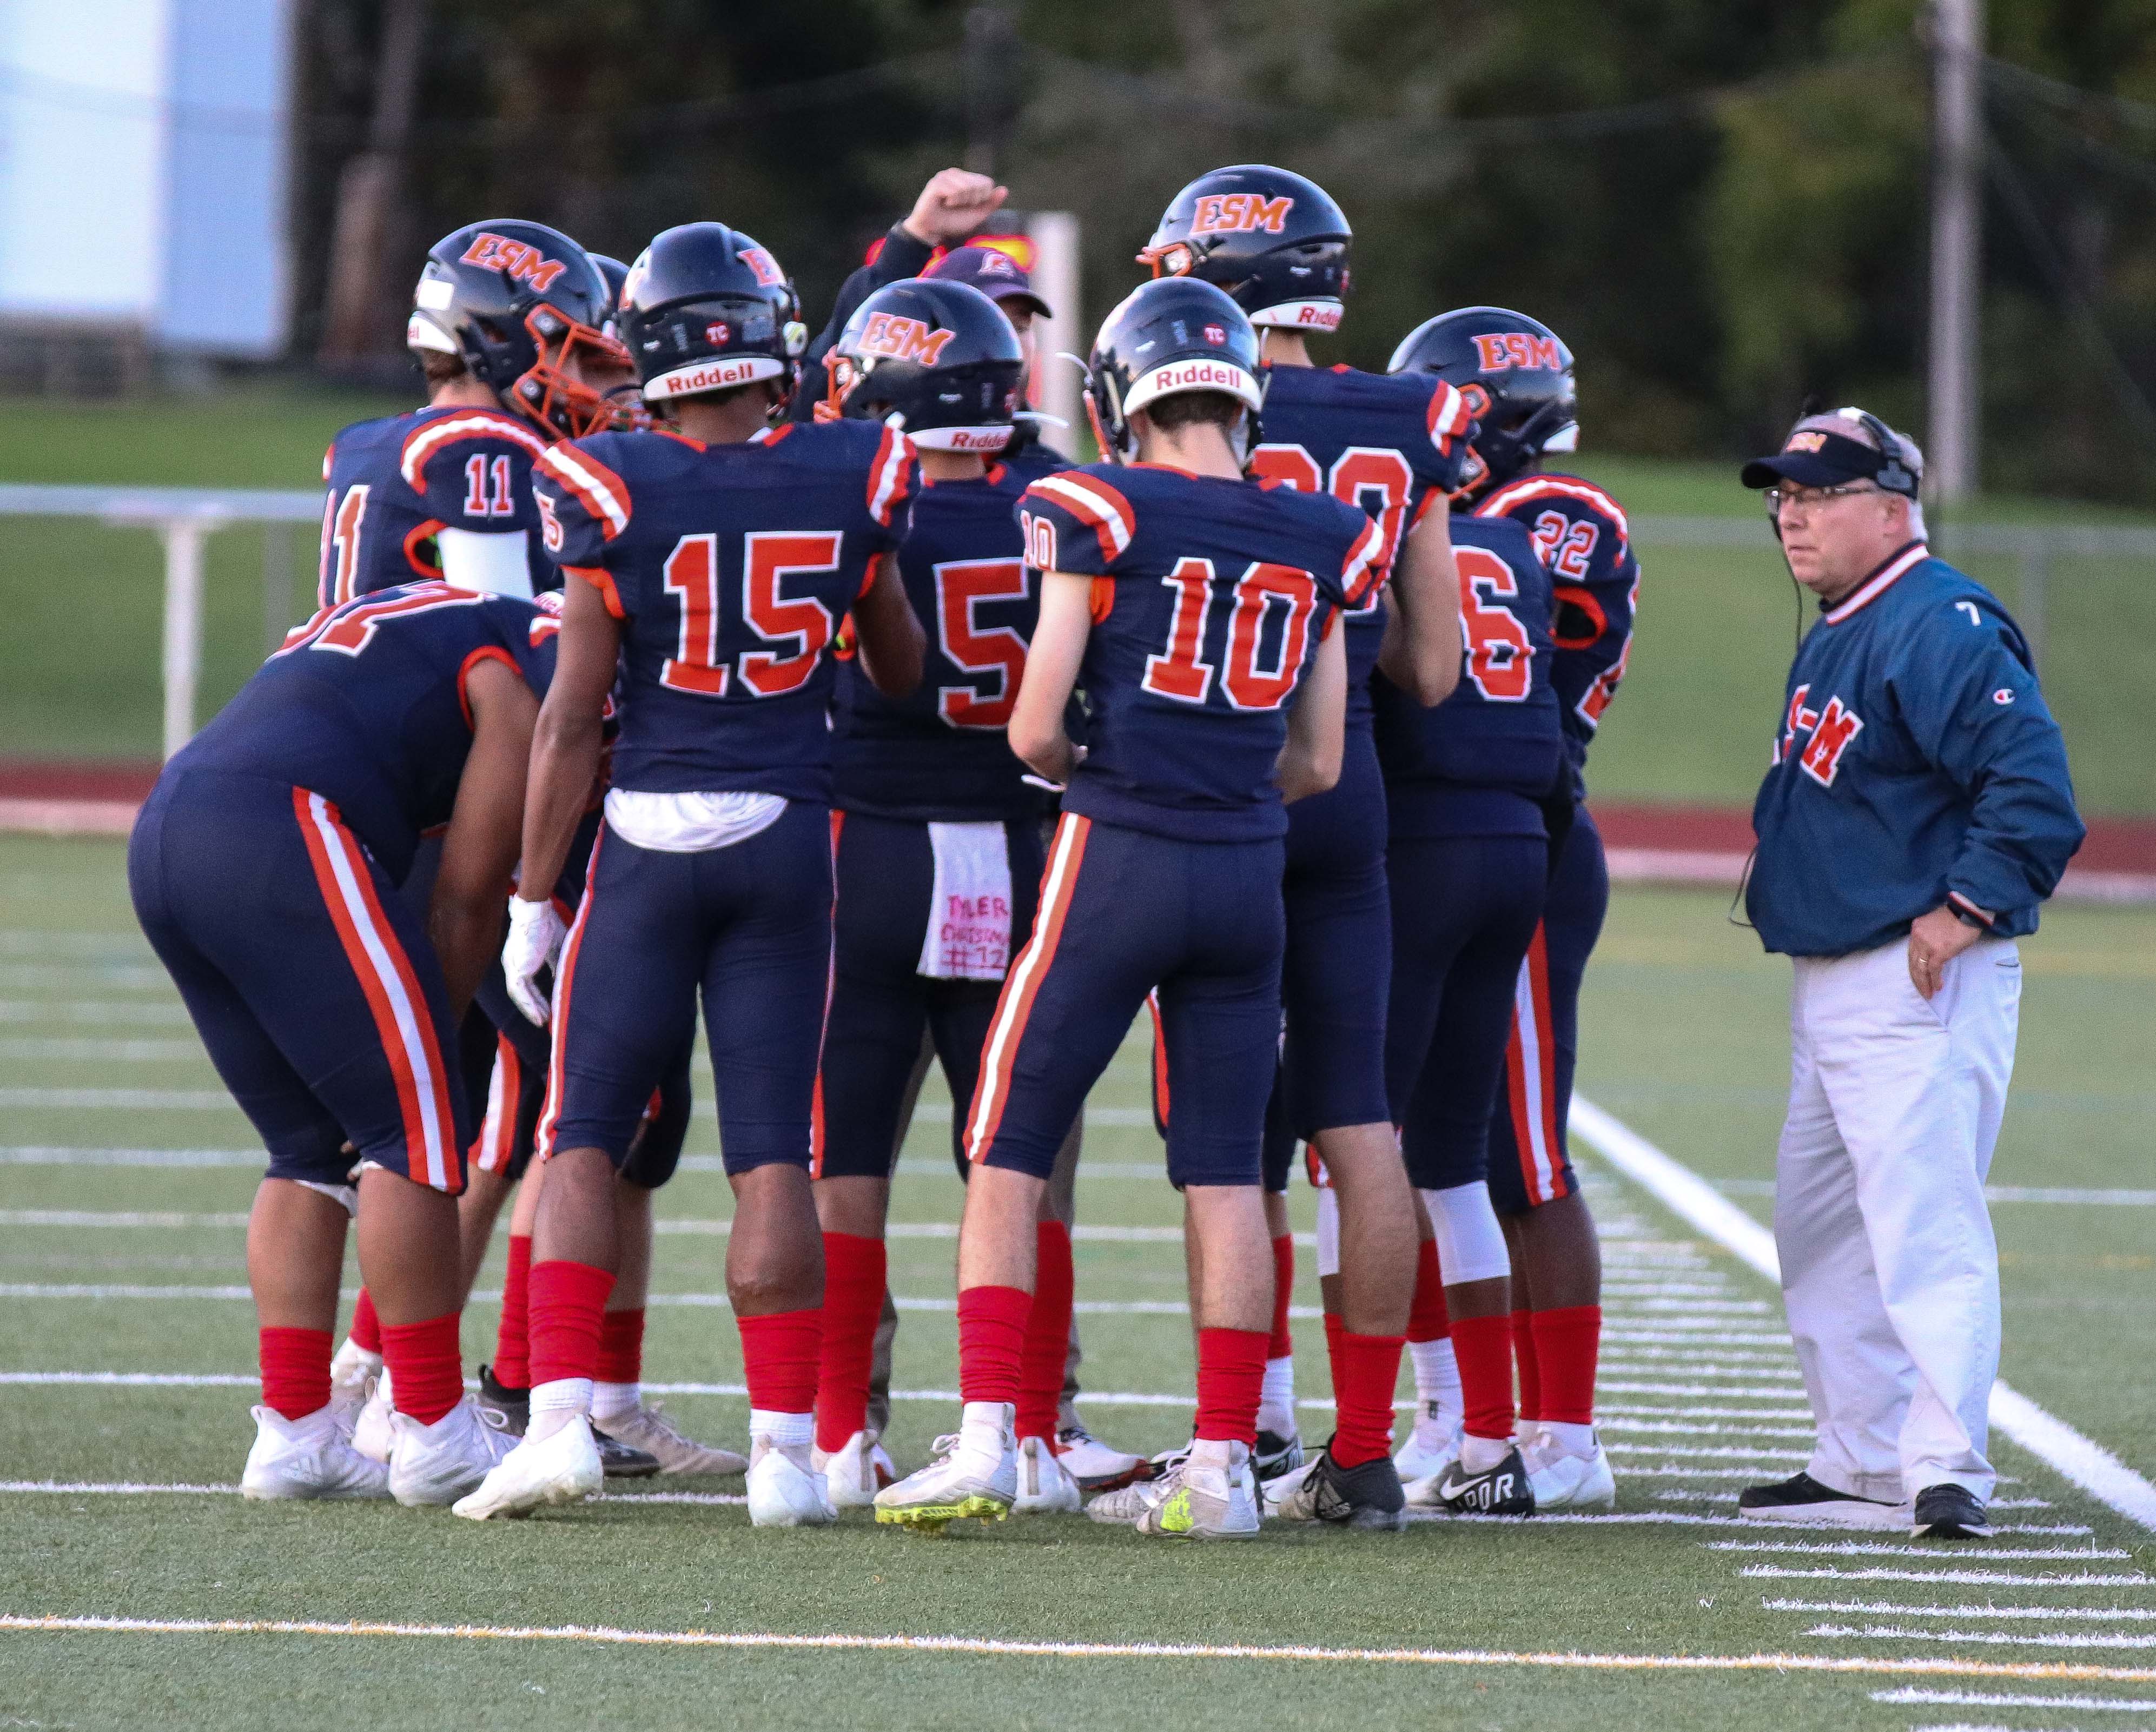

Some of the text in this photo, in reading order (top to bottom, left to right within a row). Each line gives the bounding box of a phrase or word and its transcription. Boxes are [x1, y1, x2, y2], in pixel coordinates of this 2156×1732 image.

[1191, 193, 1294, 234] ESM
[459, 233, 567, 292] ESM
[856, 311, 957, 367] ESM
[1471, 332, 1563, 374] ESM
[666, 362, 755, 394] Riddell
[1156, 364, 1241, 390] Riddell
[464, 453, 515, 517] 11
[1535, 509, 1599, 582] 22
[659, 530, 844, 698] 15
[1140, 556, 1318, 712] 10
[1451, 545, 1536, 702] 6
[1955, 601, 1981, 627] 7
[932, 557, 1029, 731] 5
